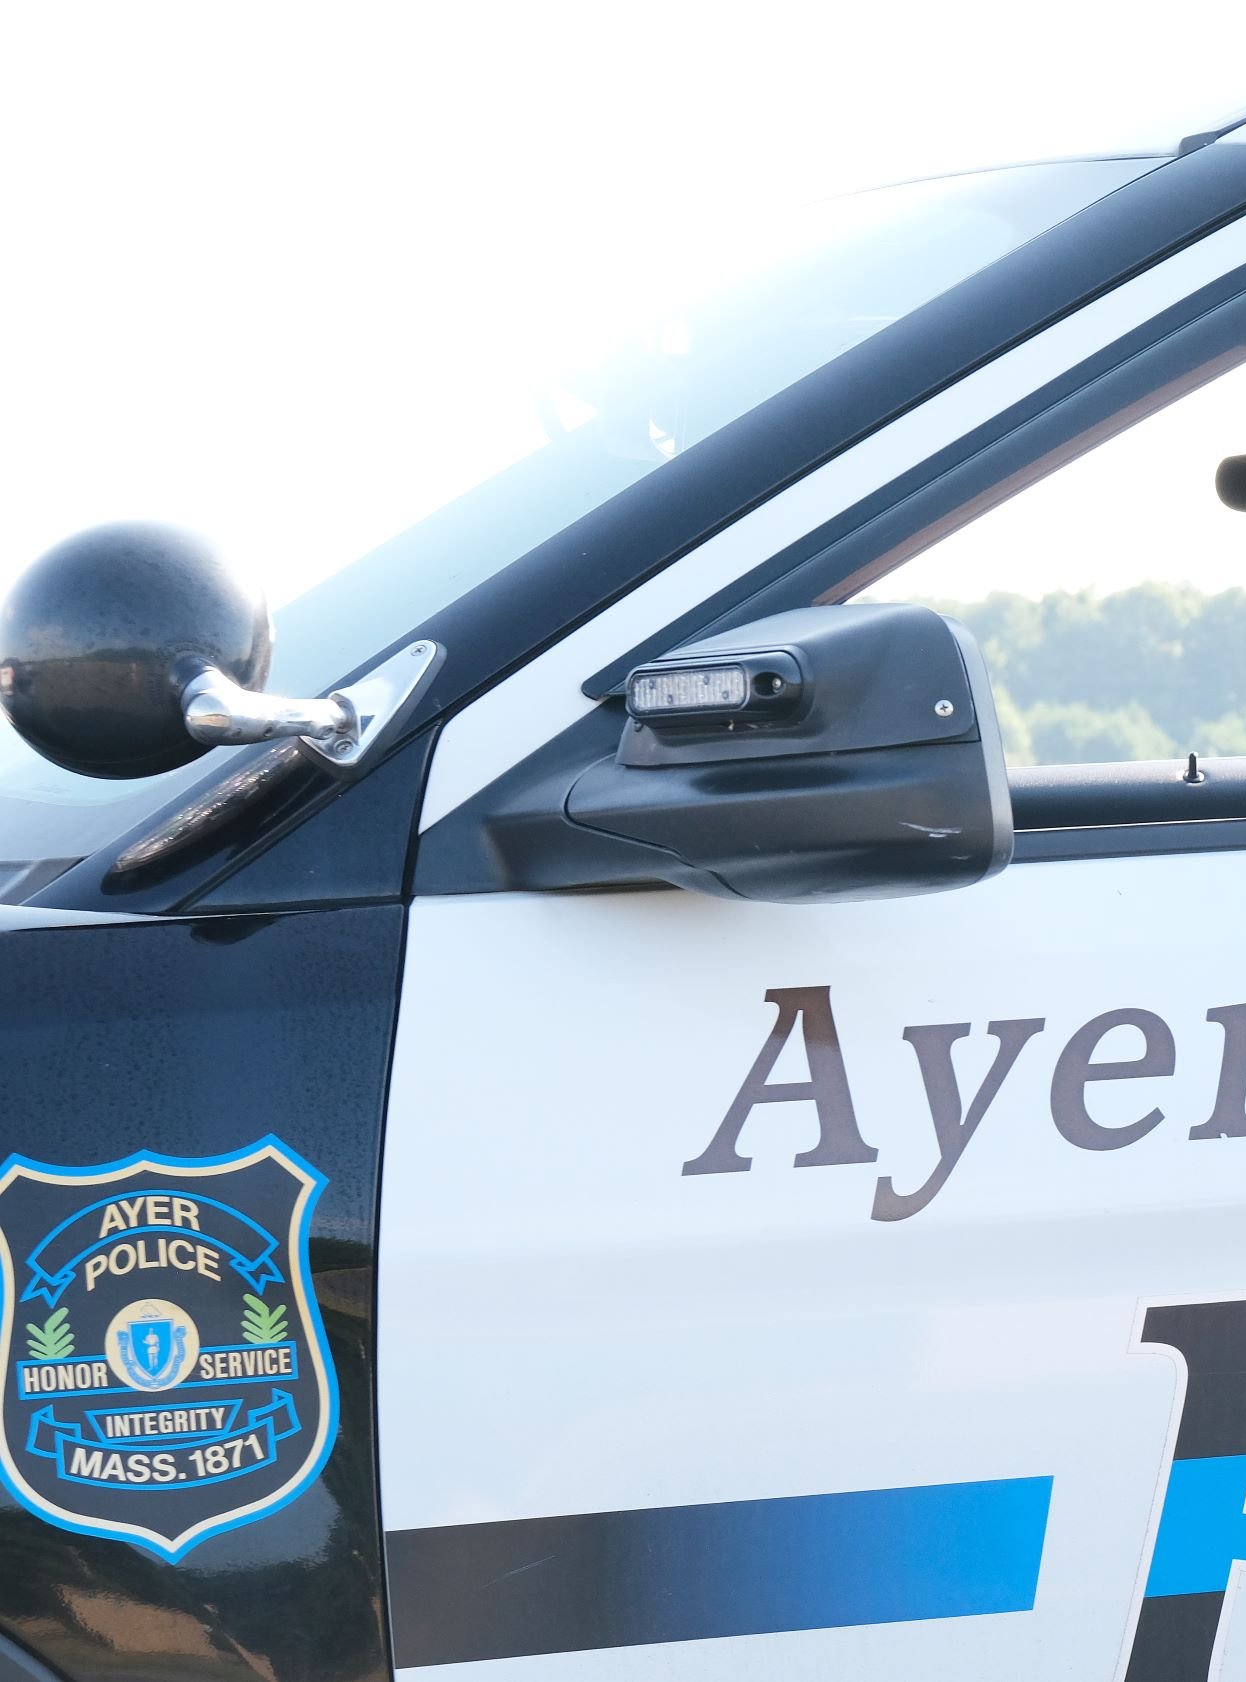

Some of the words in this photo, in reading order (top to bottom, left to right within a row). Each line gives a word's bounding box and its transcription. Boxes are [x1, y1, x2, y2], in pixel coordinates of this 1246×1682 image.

[99, 1196, 200, 1238] AYER
[85, 1238, 222, 1292] POLICE
[23, 1362, 108, 1393] HONOR
[200, 1348, 292, 1380] SERVICE
[106, 1407, 226, 1438] INTEGRITY
[70, 1447, 187, 1483] MASS.
[188, 1433, 265, 1477] 1871
